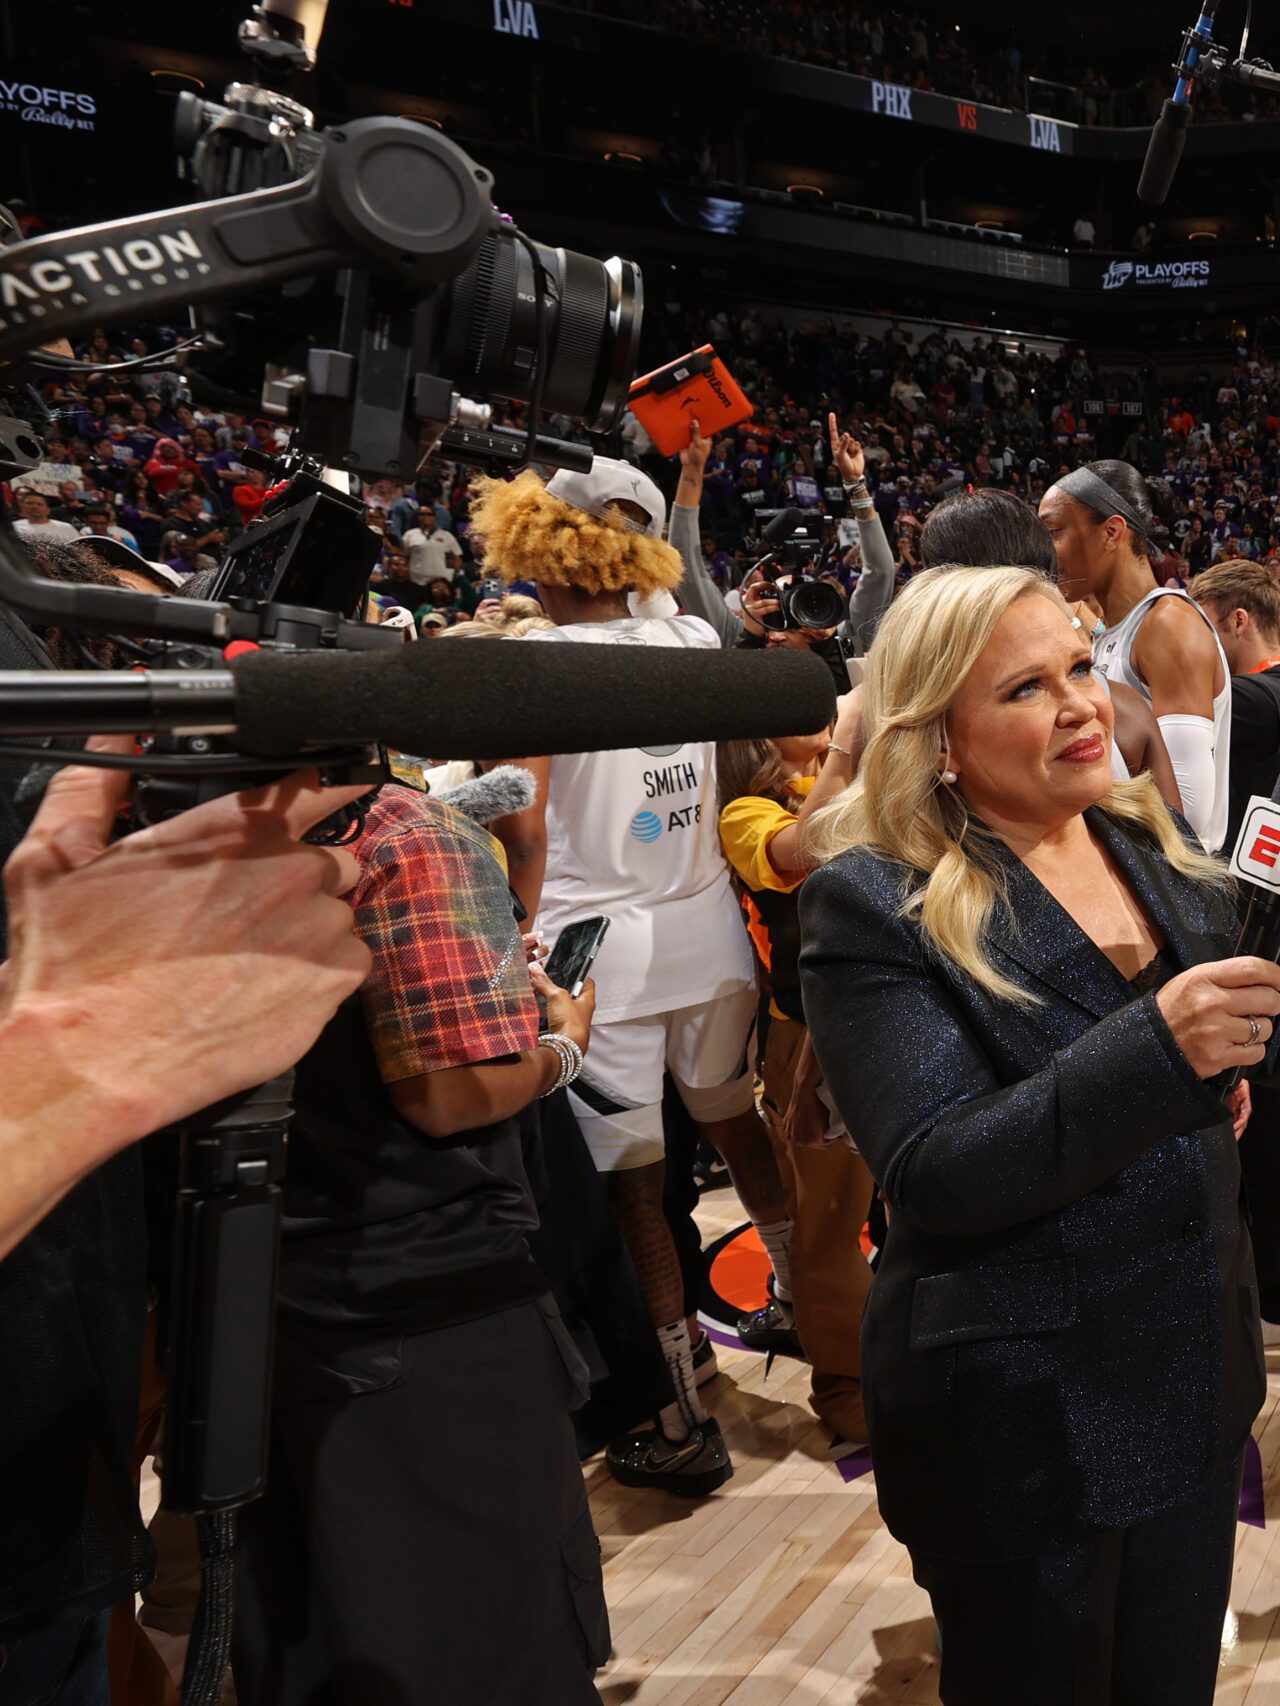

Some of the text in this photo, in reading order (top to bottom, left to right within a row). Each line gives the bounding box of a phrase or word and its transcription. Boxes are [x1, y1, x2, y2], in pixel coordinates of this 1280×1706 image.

[493, 0, 540, 40] LVA
[871, 81, 1060, 153] PHX VS LVA
[1, 229, 203, 307] ACTION
[103, 262, 211, 297] GROUP
[1135, 260, 1210, 278] PLAYOFFS
[517, 292, 553, 308] SOY
[643, 762, 698, 798] SMITH
